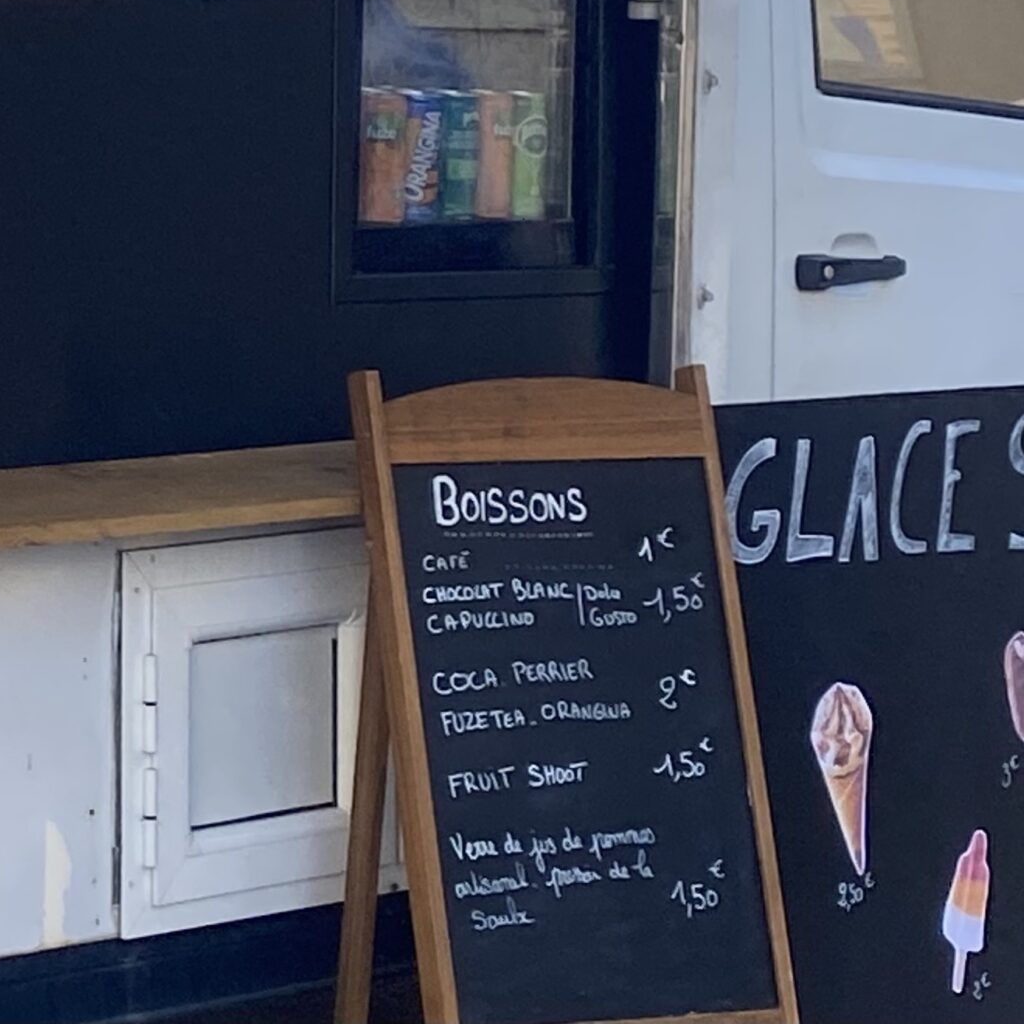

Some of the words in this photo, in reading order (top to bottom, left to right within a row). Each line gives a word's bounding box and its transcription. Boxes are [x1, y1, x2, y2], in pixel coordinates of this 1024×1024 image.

[433, 475, 587, 526] BOISSONS
[423, 551, 470, 571] CAFÉ
[423, 583, 504, 603] CHOCOLAT
[512, 578, 574, 601] BLANC
[427, 611, 534, 633] CAPUCCINO
[512, 659, 593, 684] PERRIER
[448, 766, 515, 798] FRUIT
[528, 762, 588, 787] SHOOT
[504, 832, 523, 854] de
[529, 831, 558, 874] jus
[562, 827, 583, 851] de
[609, 861, 632, 878] de
[632, 849, 654, 877] la
